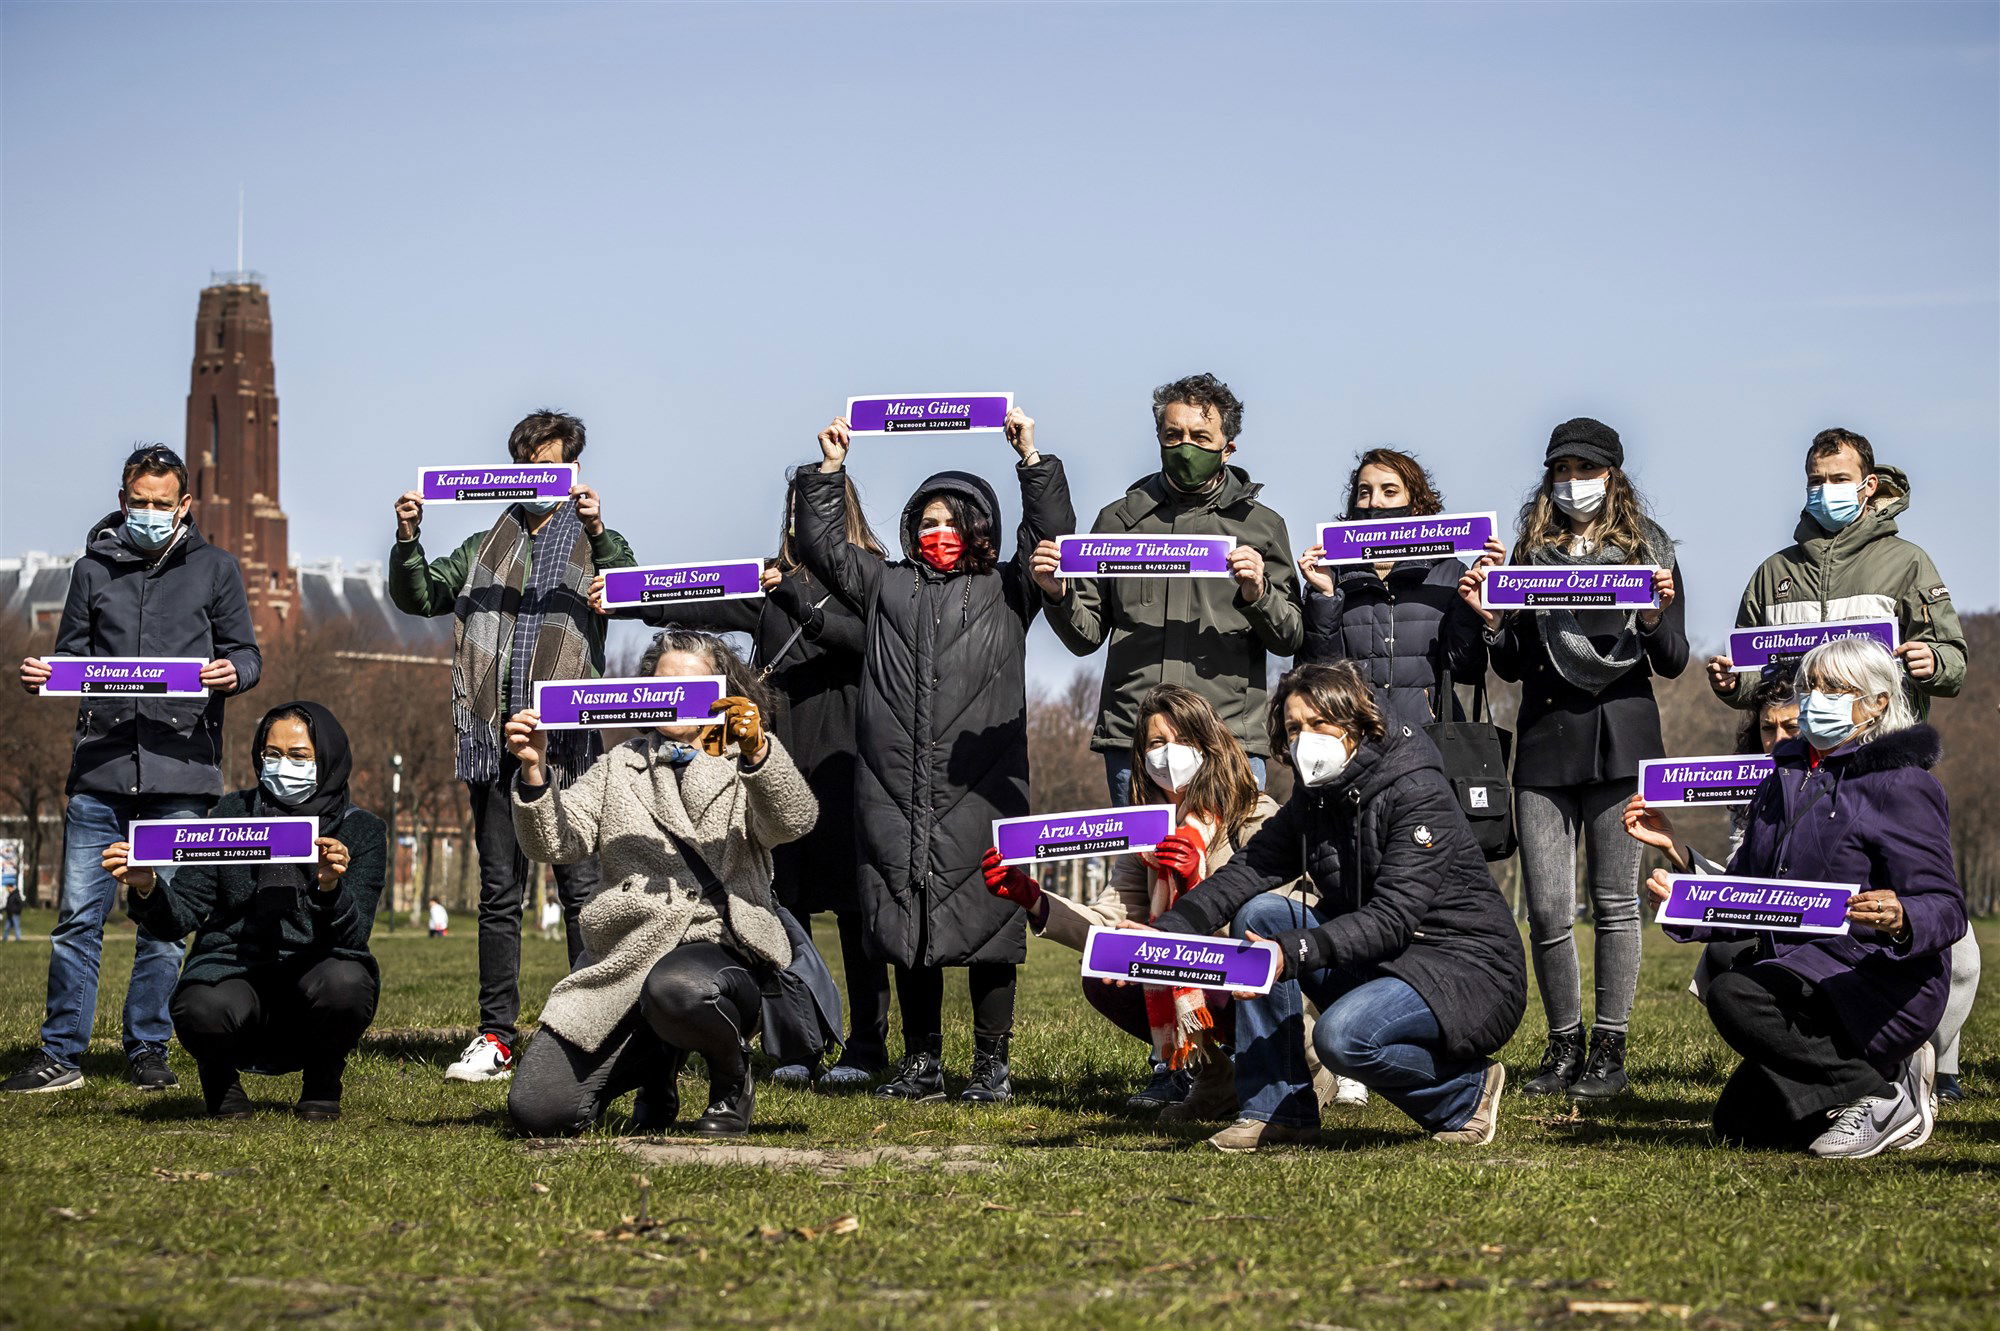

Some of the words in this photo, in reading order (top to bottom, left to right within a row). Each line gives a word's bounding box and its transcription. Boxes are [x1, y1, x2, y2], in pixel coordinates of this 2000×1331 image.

[885, 402, 924, 417] Miraş
[928, 401, 970, 417] Güneş
[895, 421, 927, 429] vermoord
[436, 473, 480, 486] Karina
[482, 471, 557, 485] Demchenko
[466, 490, 496, 498] vermoord
[1343, 529, 1387, 544] Naam
[1390, 526, 1417, 540] niet
[1420, 521, 1471, 539] bekend
[1079, 542, 1132, 557] Halime
[1136, 542, 1208, 557] Türkaslan
[1373, 546, 1407, 556] vermoord
[1109, 563, 1143, 571] vermoord
[643, 571, 686, 588] Yazgül
[689, 570, 720, 584] Soro
[1497, 574, 1565, 591] Beyzanur
[1566, 571, 1598, 588] Özel
[1601, 574, 1643, 588] Fidan
[651, 590, 682, 599] vermoord
[1536, 595, 1569, 603] vermoord
[1752, 633, 1818, 650] Gülbahar
[85, 664, 129, 677] Selvan
[131, 664, 165, 678] Acar
[591, 712, 627, 720] vermoord
[1662, 767, 1733, 783] Mihrican
[1736, 764, 1774, 780] Ekm
[1696, 789, 1733, 798] vermoord
[174, 828, 214, 842] Emel
[217, 827, 270, 842] Tokkal
[1039, 824, 1075, 839] Arzu
[1077, 819, 1123, 838] Aygün
[185, 850, 221, 858] vermoord
[1047, 843, 1082, 854] vermoord
[1685, 885, 1718, 902] Nur
[1719, 886, 1766, 905] Cemil
[1766, 889, 1832, 911] Hüseyin
[1716, 912, 1752, 921] vermoord
[1135, 941, 1170, 962] Ayşe
[1173, 944, 1225, 965] Yaylan
[1141, 967, 1176, 978] vermoord
